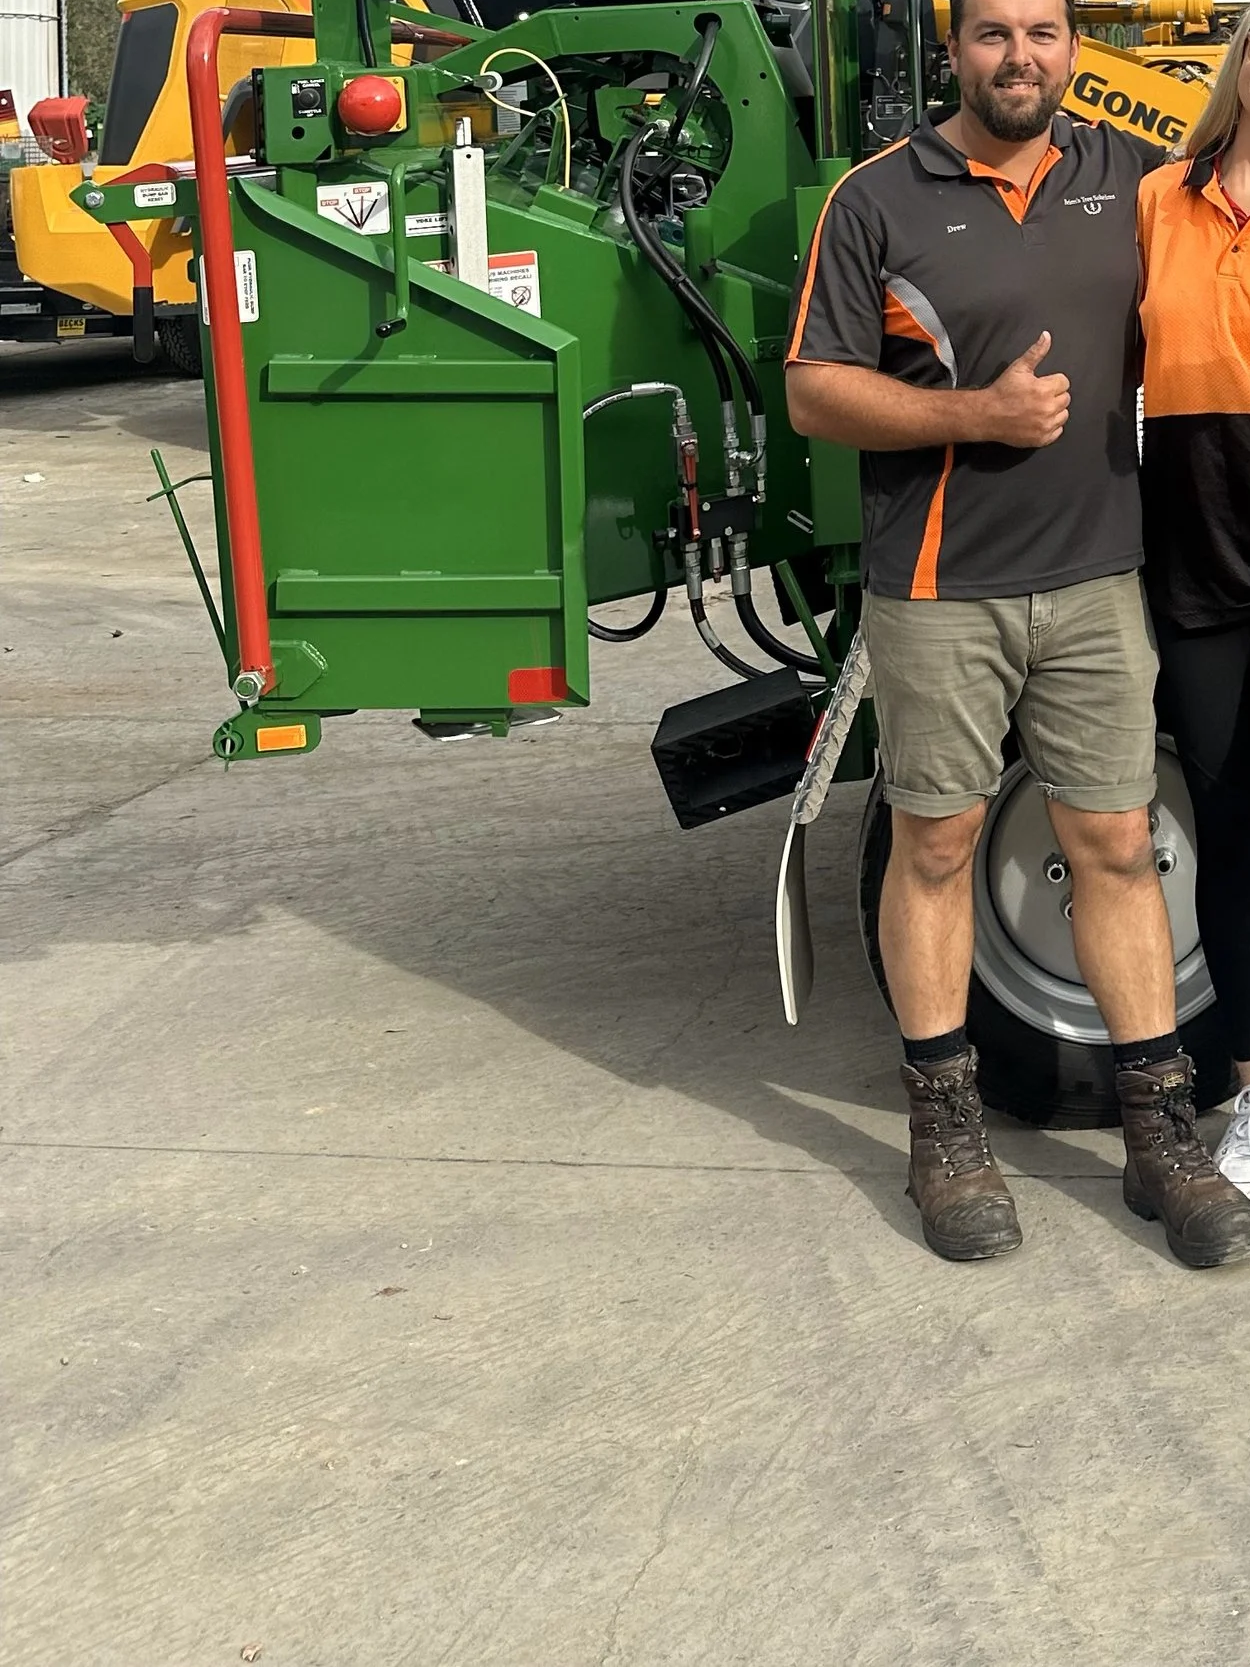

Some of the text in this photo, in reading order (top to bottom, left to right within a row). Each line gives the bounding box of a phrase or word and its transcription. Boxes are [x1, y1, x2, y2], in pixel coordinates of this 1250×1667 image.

[1073, 71, 1188, 144] GONG
[1093, 193, 1116, 202] Solutions
[946, 223, 967, 234] Drew
[59, 318, 84, 328] BECKS
